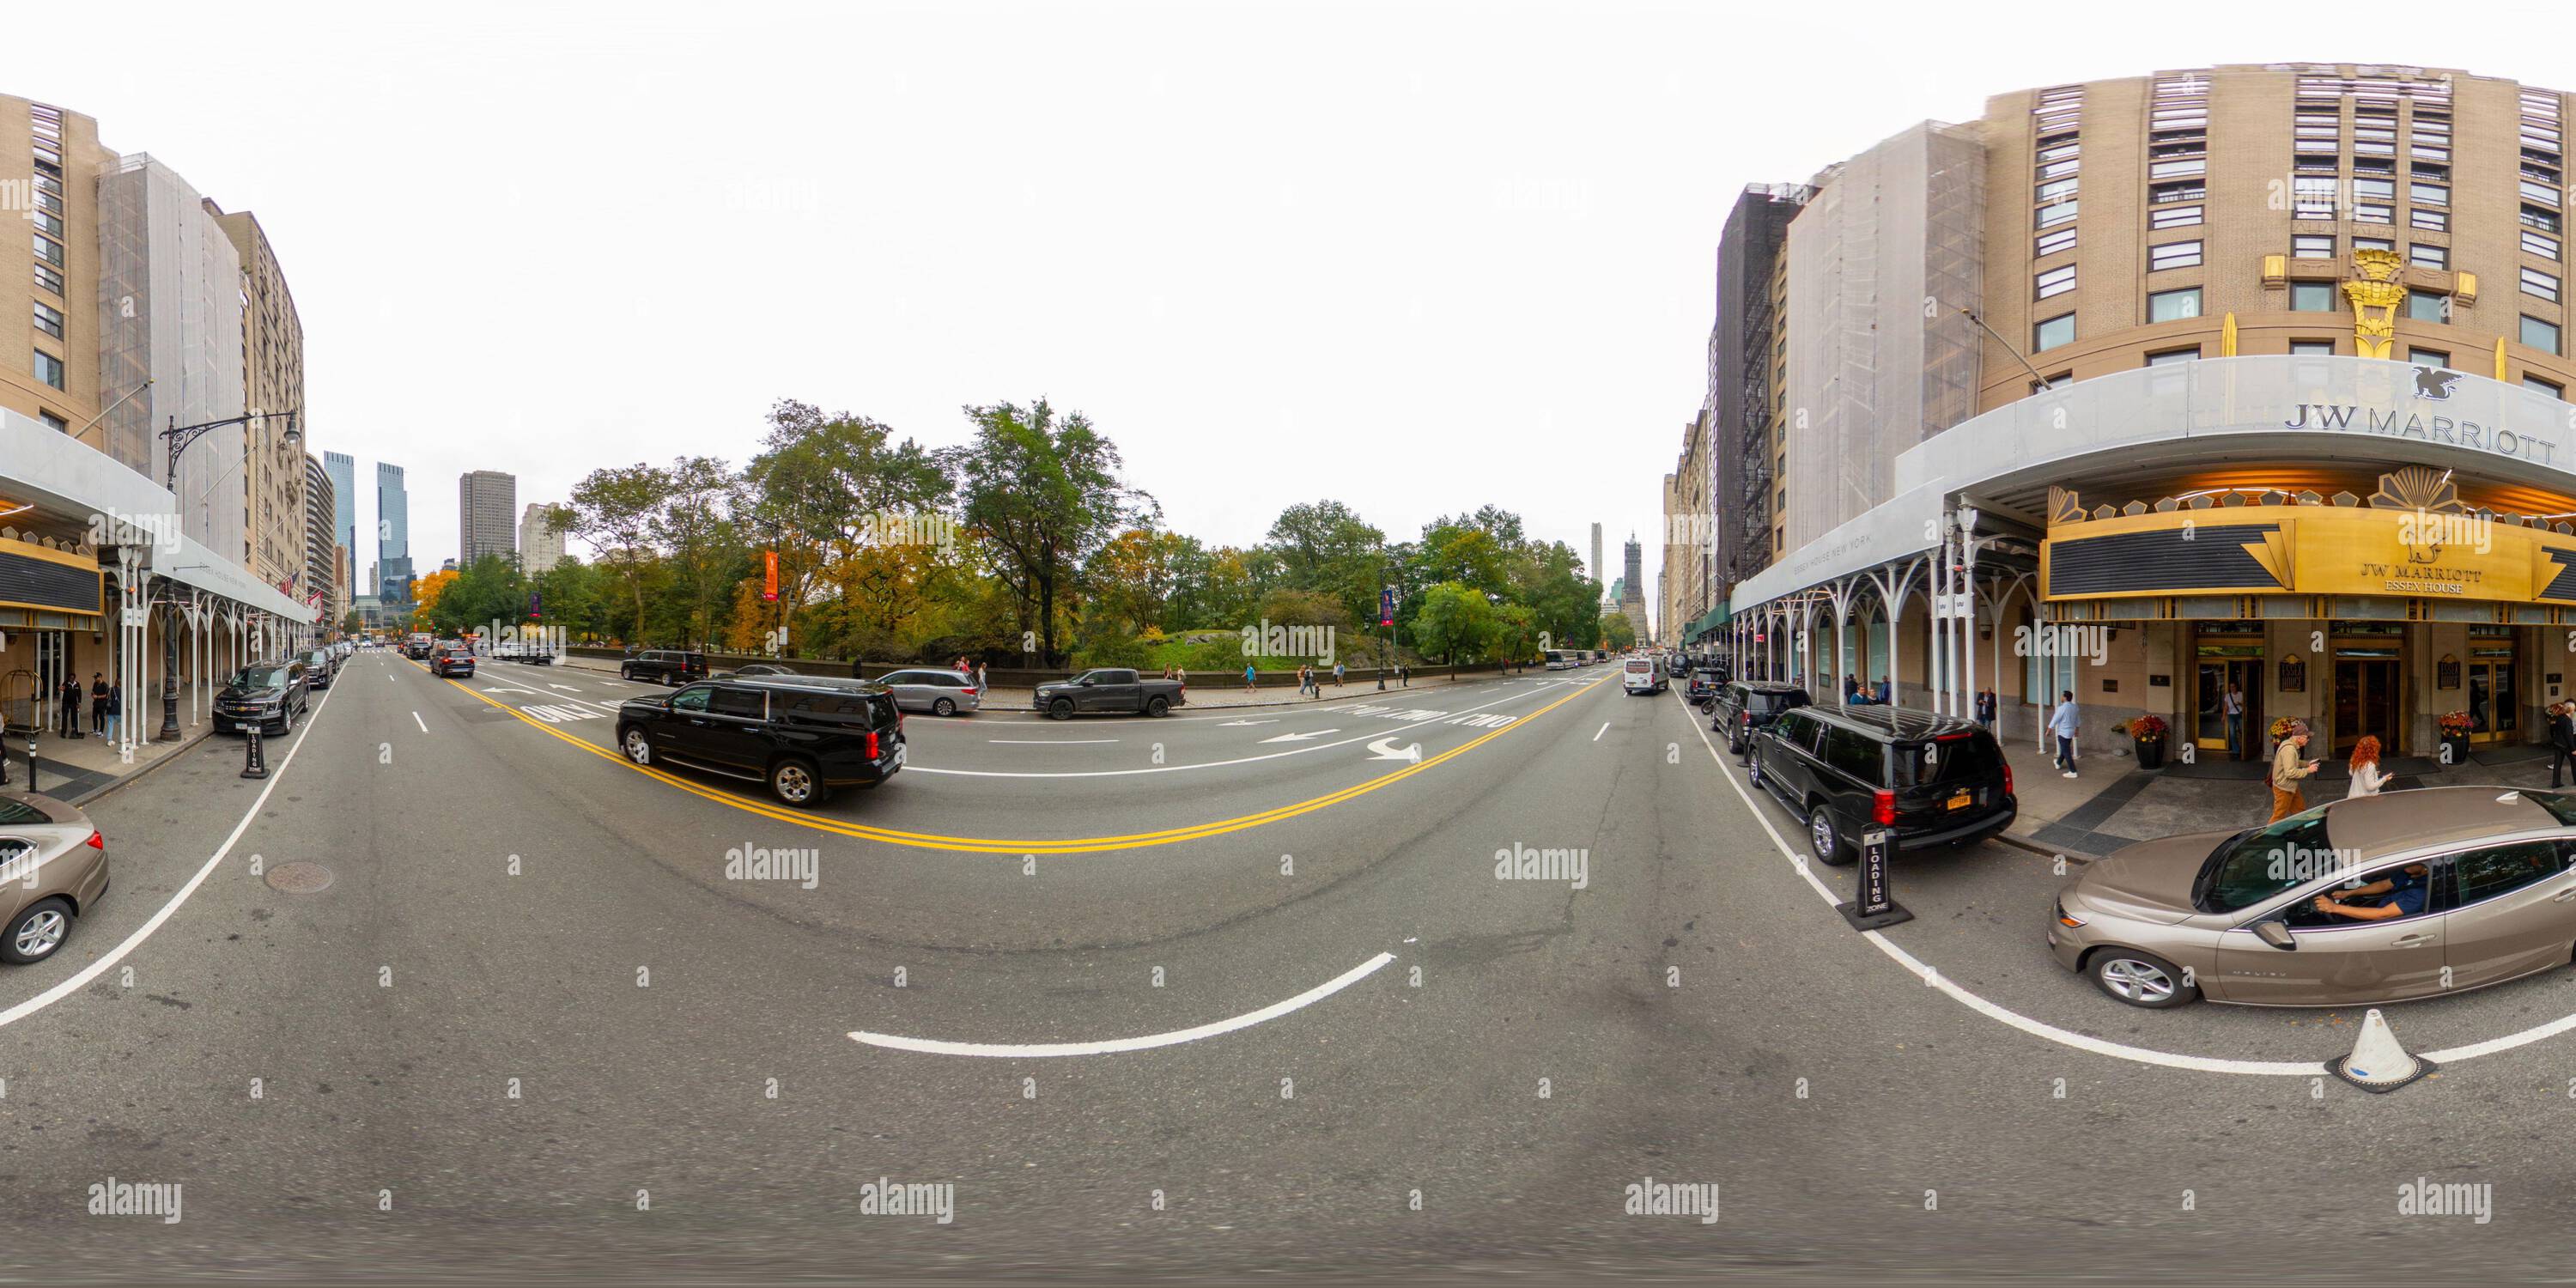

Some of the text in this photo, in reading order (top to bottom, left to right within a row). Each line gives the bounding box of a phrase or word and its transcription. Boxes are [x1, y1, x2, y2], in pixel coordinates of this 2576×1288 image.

[2285, 404, 2556, 465] JW MARRIOTT
[2360, 563, 2482, 582] JW MARRIOTT
[2385, 580, 2463, 594] ESSEX HOUSE
[519, 703, 608, 723] ONLY
[1443, 713, 1518, 728] ONLY
[1871, 847, 1882, 902] LOADING
[1867, 902, 1888, 912] ZONE
